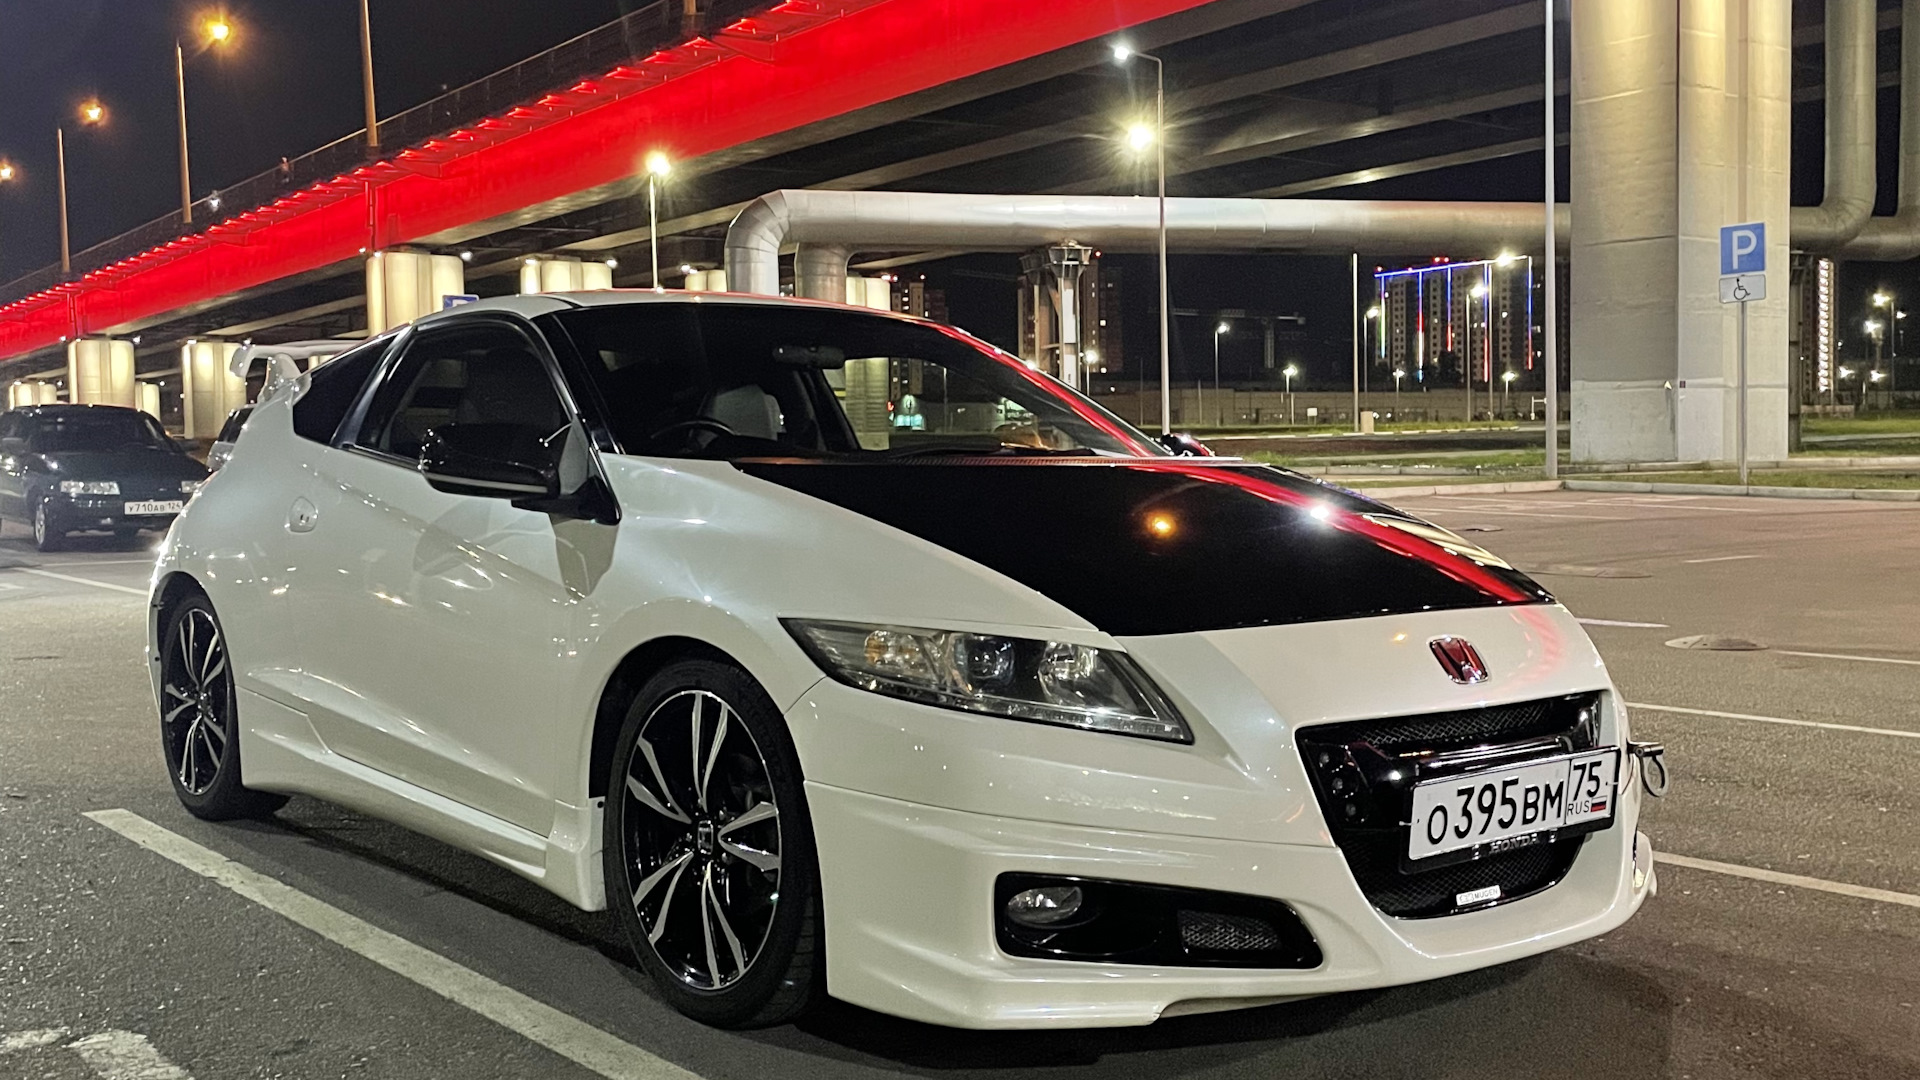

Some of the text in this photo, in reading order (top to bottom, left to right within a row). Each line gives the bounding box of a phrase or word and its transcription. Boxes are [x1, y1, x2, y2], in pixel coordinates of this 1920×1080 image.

[1732, 229, 1757, 270] P
[1427, 760, 1603, 845] О395ВМ 75
[1566, 799, 1590, 817] RUS
[1489, 833, 1540, 854] HONDA
